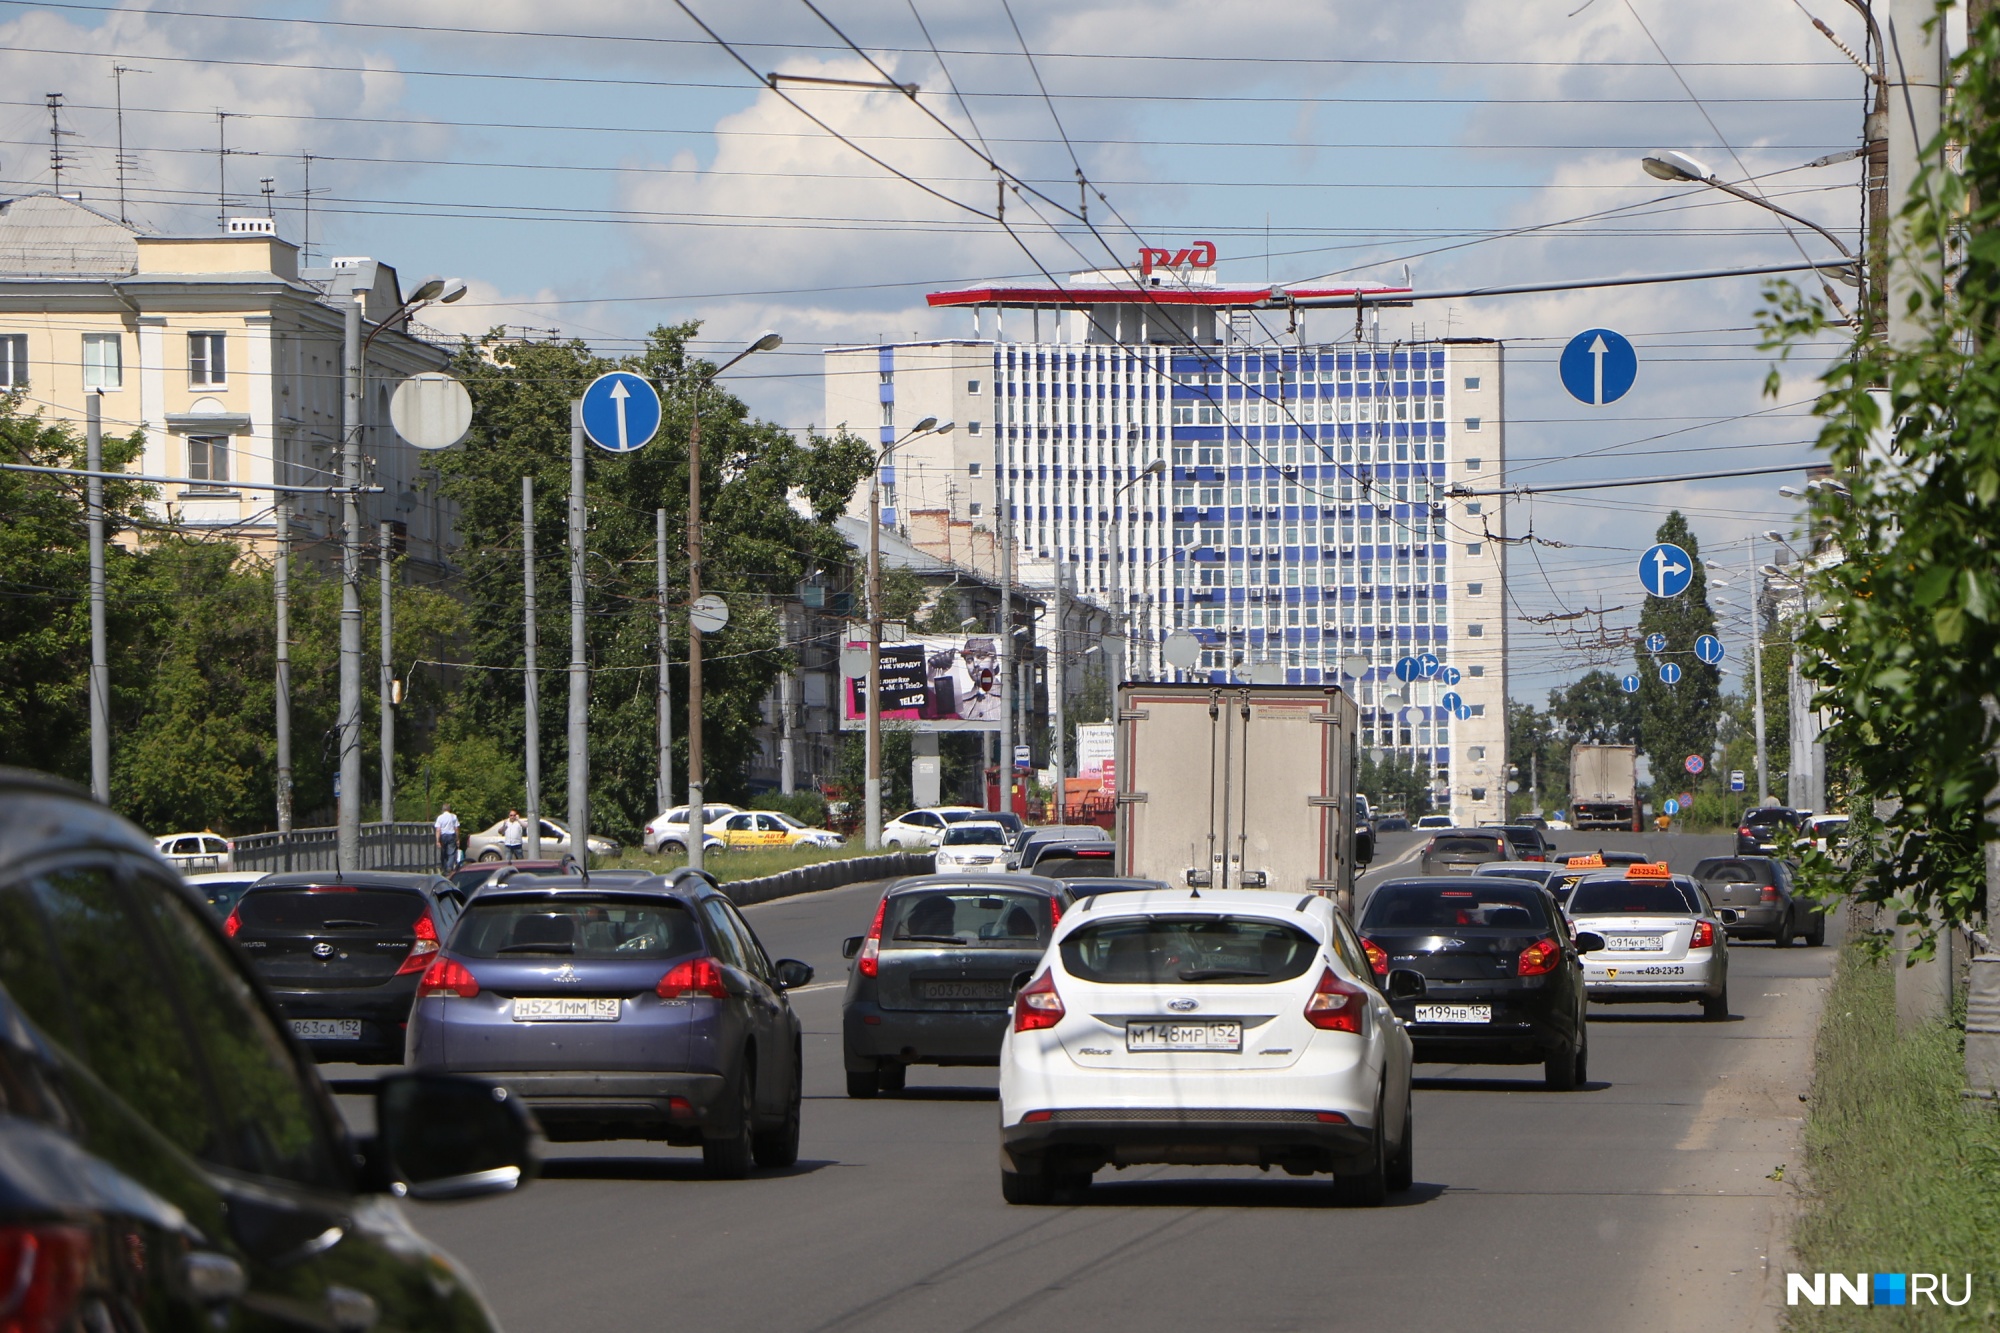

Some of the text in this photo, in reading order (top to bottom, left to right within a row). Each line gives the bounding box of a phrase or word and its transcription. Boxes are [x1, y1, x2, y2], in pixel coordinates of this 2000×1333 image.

[899, 694, 925, 706] TELE2
[1610, 937, 1661, 948] О914КР 152
[1645, 966, 1684, 976] 423-23-23
[520, 999, 617, 1015] Н521ММ 152
[1417, 1005, 1489, 1019] М199НВ 152
[294, 1020, 359, 1034] 863СА 152
[1132, 1023, 1237, 1042] М148МР 152
